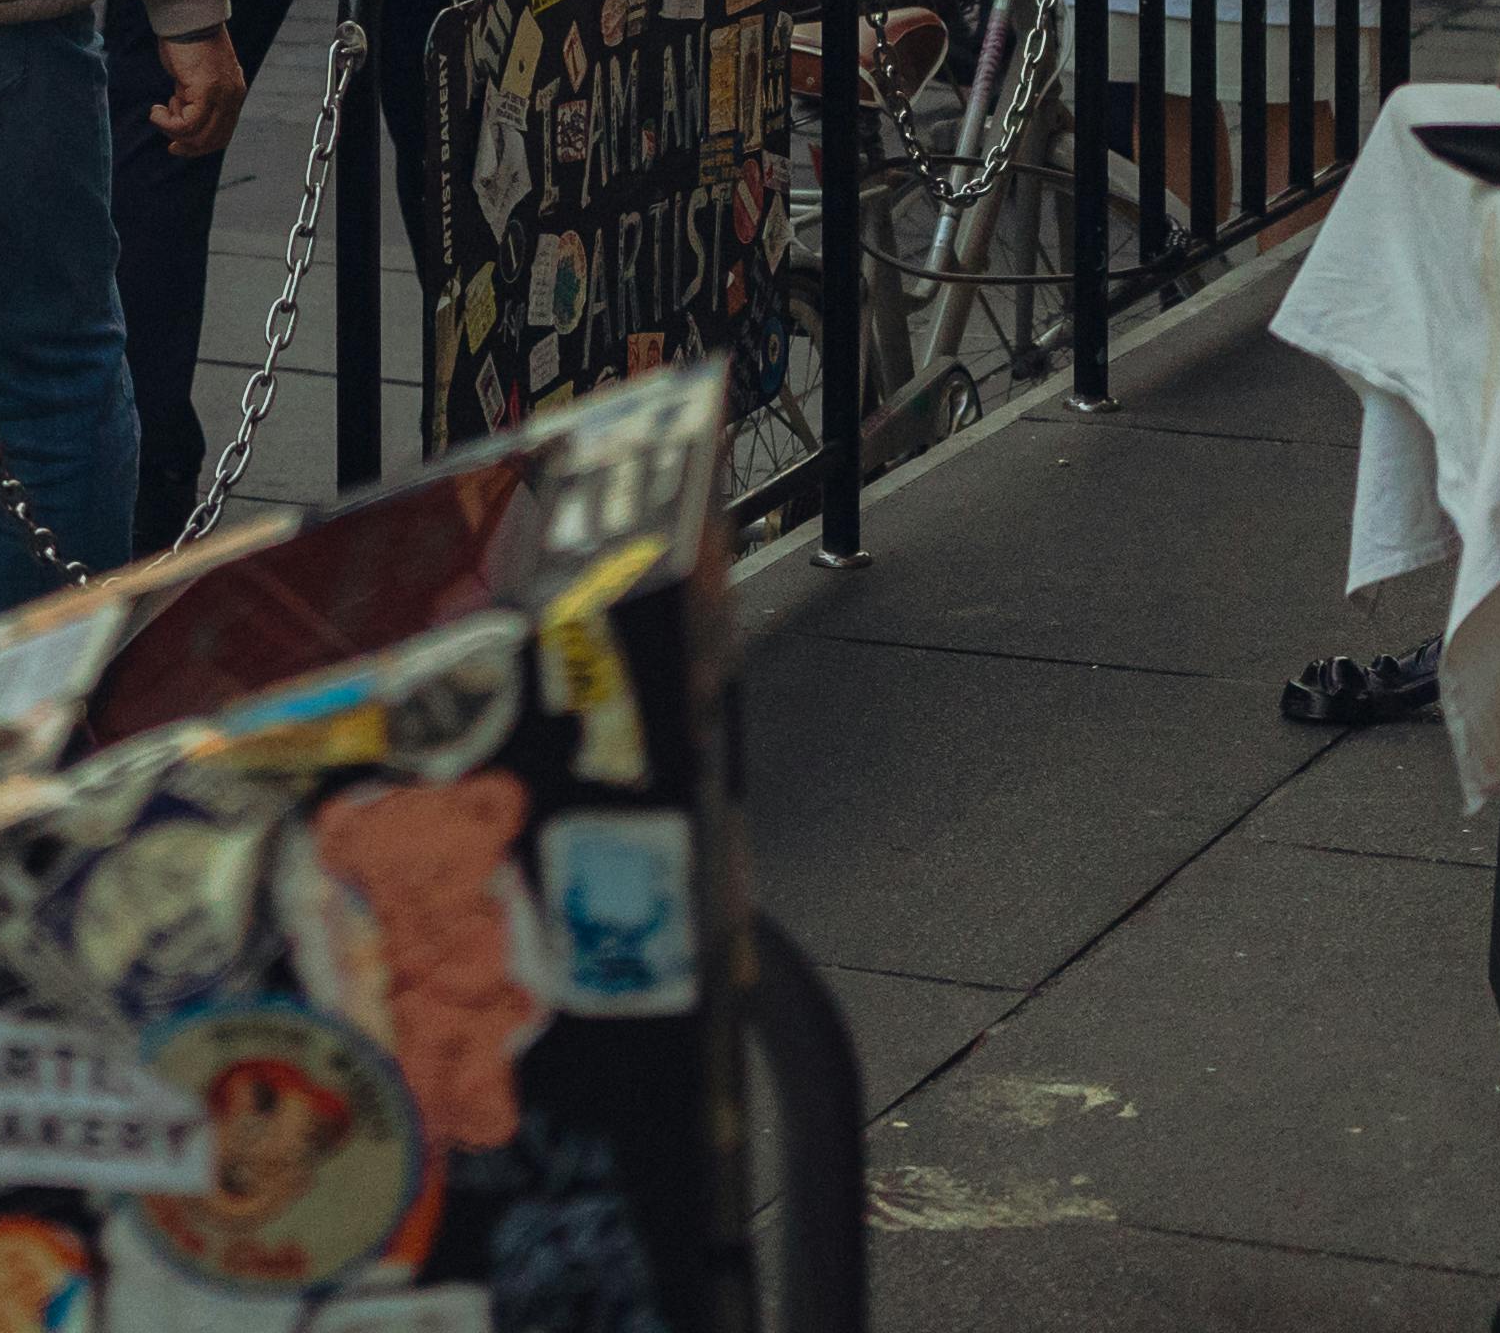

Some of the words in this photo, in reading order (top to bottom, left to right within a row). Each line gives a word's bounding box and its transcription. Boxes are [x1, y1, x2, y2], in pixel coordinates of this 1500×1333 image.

[438, 52, 449, 162] BAKERY
[441, 170, 453, 265] ARTIST
[580, 182, 732, 372] ARTIST
